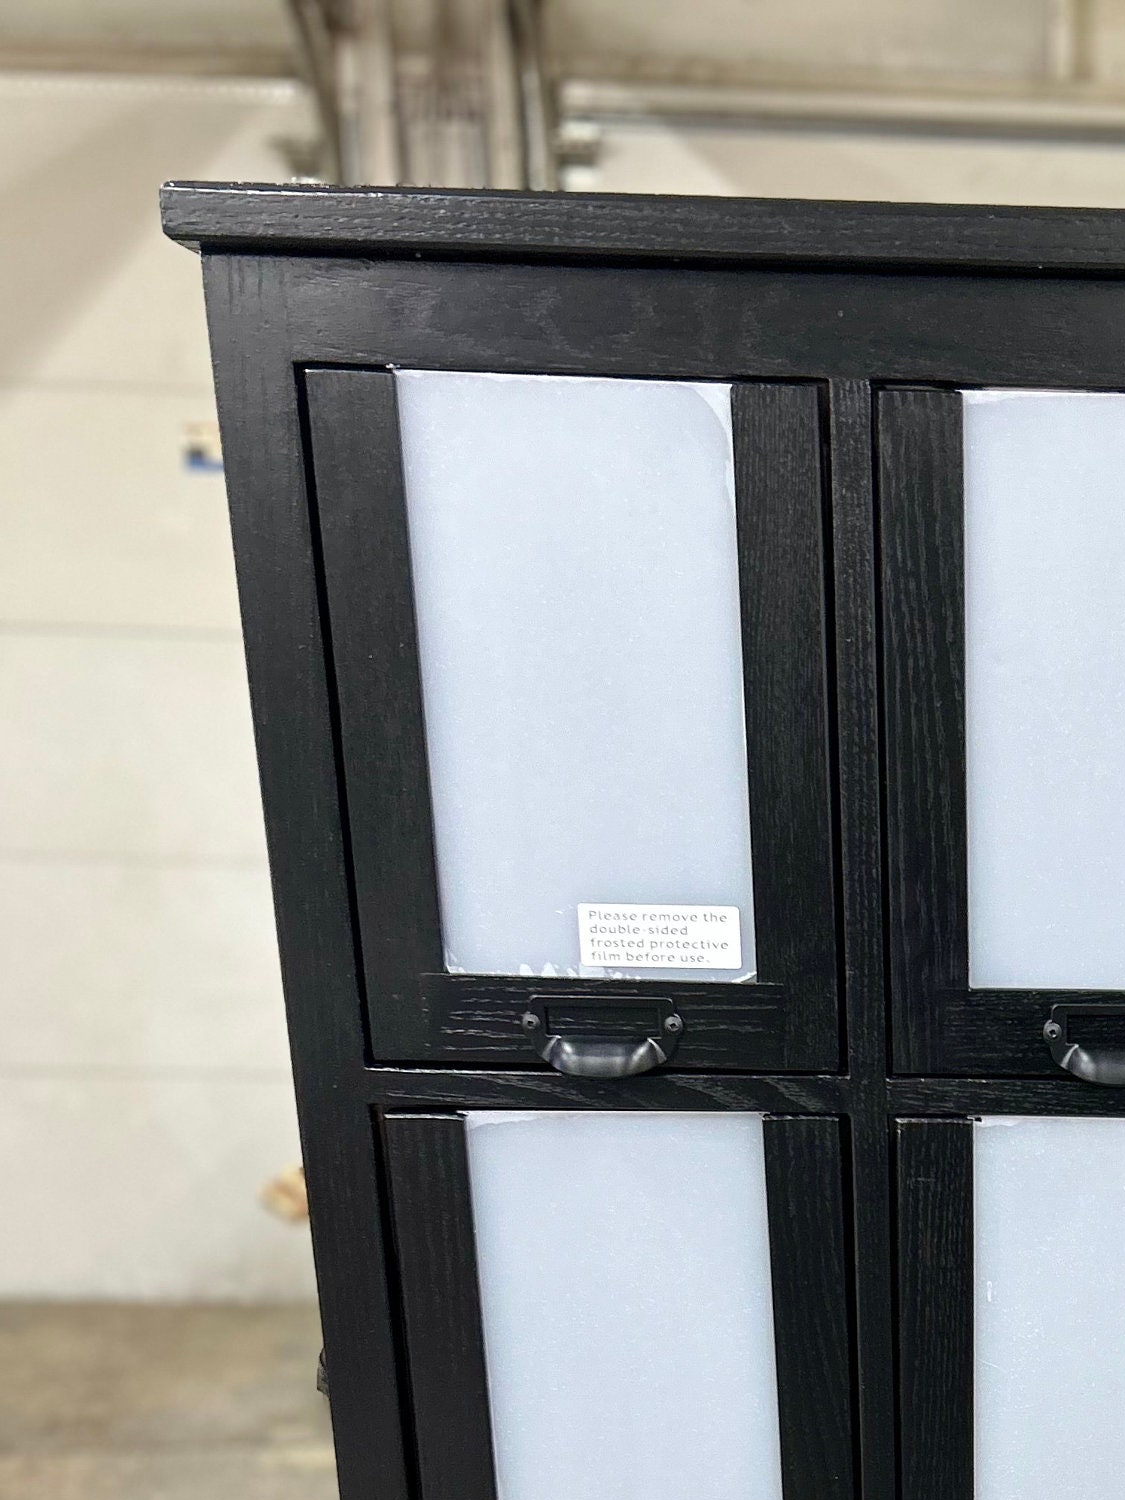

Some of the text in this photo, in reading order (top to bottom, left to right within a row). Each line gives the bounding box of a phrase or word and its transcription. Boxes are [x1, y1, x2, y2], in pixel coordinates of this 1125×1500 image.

[588, 909, 728, 923] Please remove the
[590, 936, 729, 951] frosted protective
[591, 950, 710, 963] film before use.
